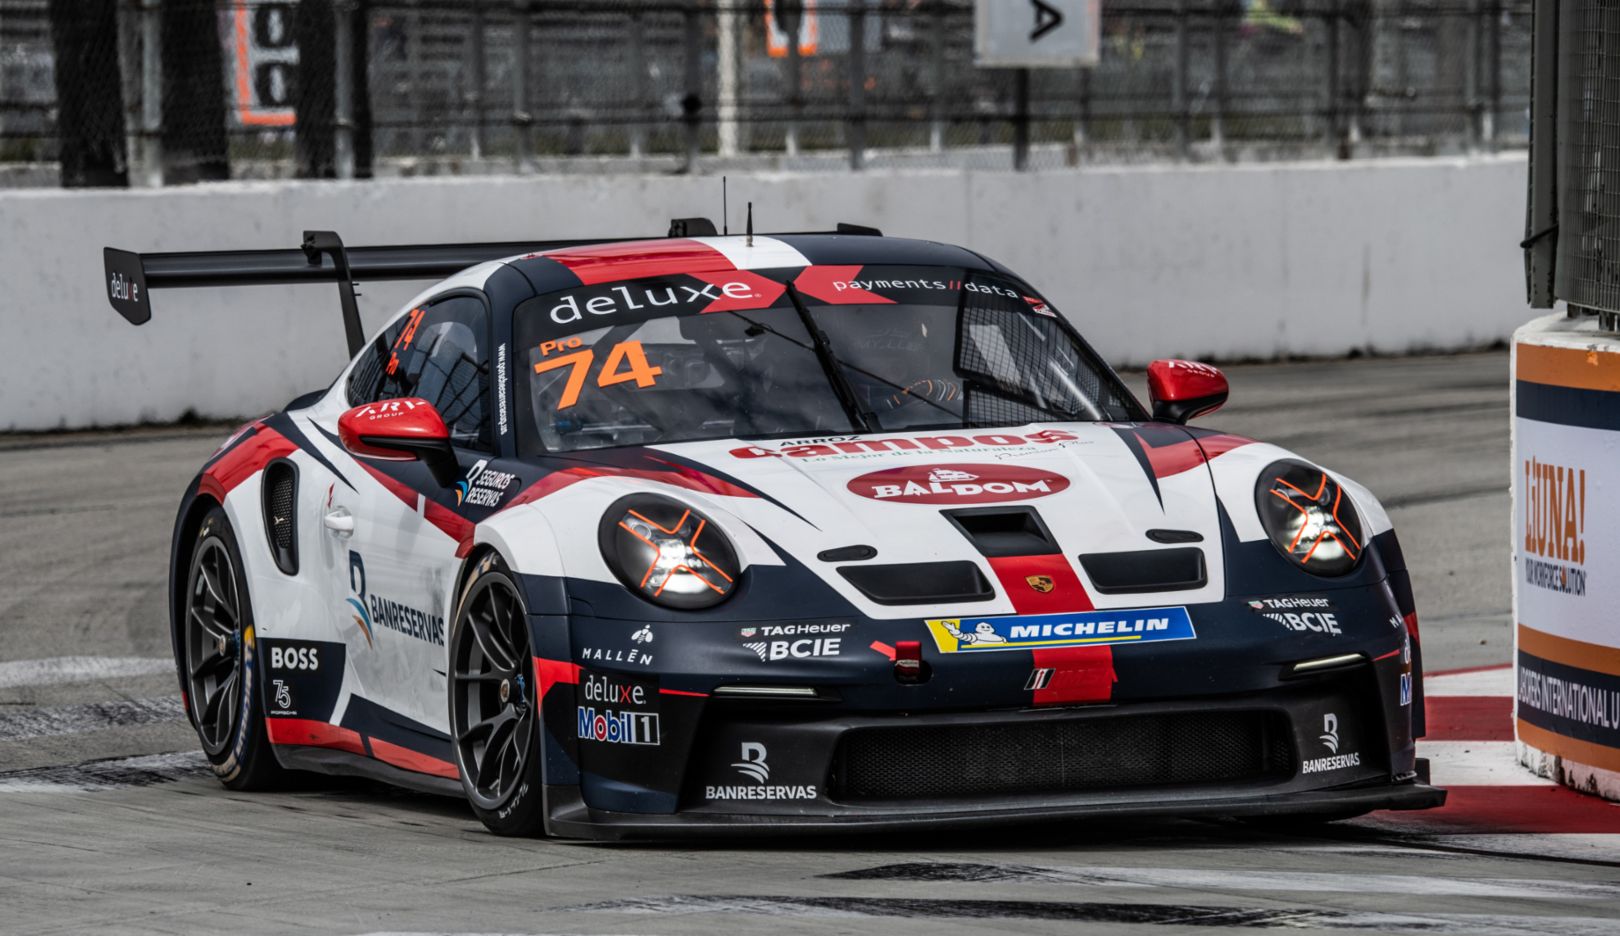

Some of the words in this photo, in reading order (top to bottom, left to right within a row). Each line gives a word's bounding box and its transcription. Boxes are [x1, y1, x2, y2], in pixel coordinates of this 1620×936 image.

[832, 278, 946, 293] payments
[964, 281, 1019, 299] data
[549, 281, 753, 324] deluxe
[540, 336, 582, 356] Pro
[533, 340, 663, 412] 74
[369, 411, 405, 421] GROUP
[780, 435, 862, 447] ARROZ
[872, 479, 1052, 499] BALDOM
[370, 593, 445, 648] BANRESERVAS
[1010, 618, 1169, 639] MICHELIN
[1284, 612, 1343, 634] BCIE
[271, 647, 319, 671] BOSS
[769, 637, 842, 661] BCIE
[585, 674, 645, 704] deluxe
[1541, 674, 1610, 728] INTERNATIONAL
[578, 705, 632, 743] Mobil
[1302, 751, 1360, 774] BANRESERVAS
[705, 785, 818, 800] BANRESERVAS
